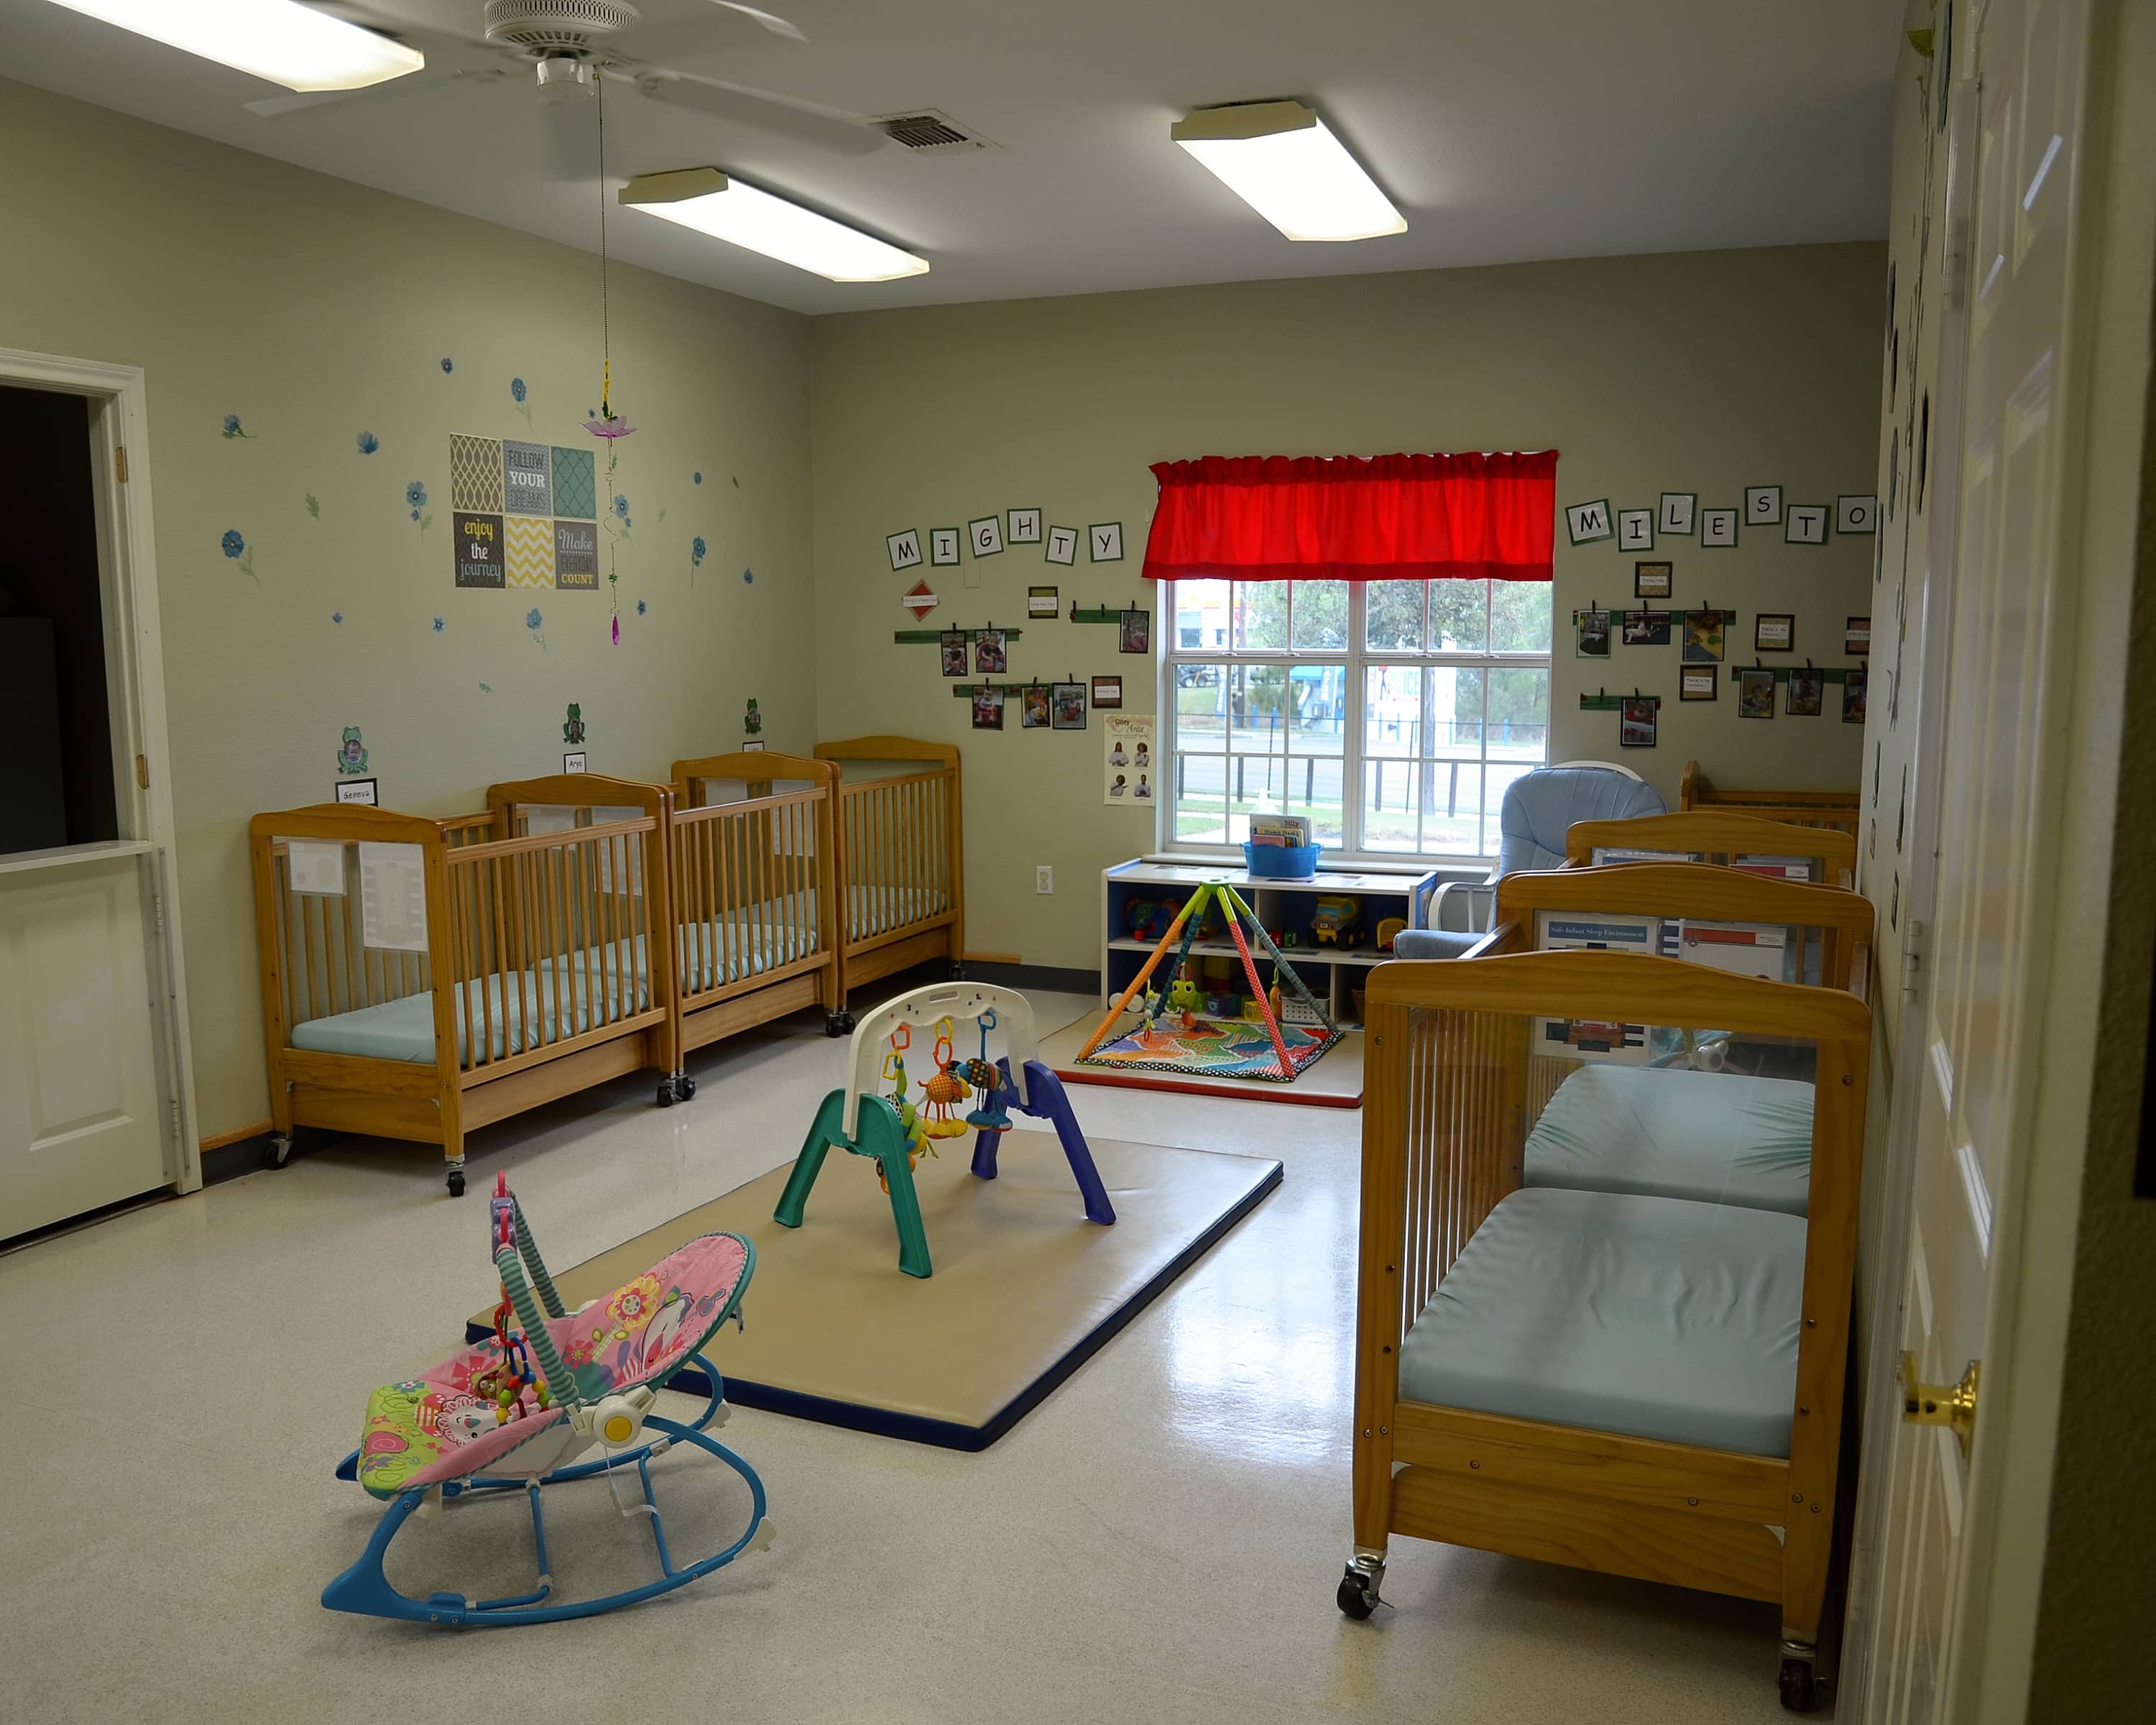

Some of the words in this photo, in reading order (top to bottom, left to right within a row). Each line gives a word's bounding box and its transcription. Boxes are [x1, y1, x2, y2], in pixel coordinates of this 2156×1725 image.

[508, 450, 545, 470] FOLLOW
[510, 471, 545, 487] YOUR
[464, 518, 493, 540] enjoy
[558, 529, 593, 551] Make
[471, 543, 488, 559] the
[460, 559, 500, 581] journey
[561, 574, 594, 584] COUNT
[1586, 928, 1603, 937] Sleep
